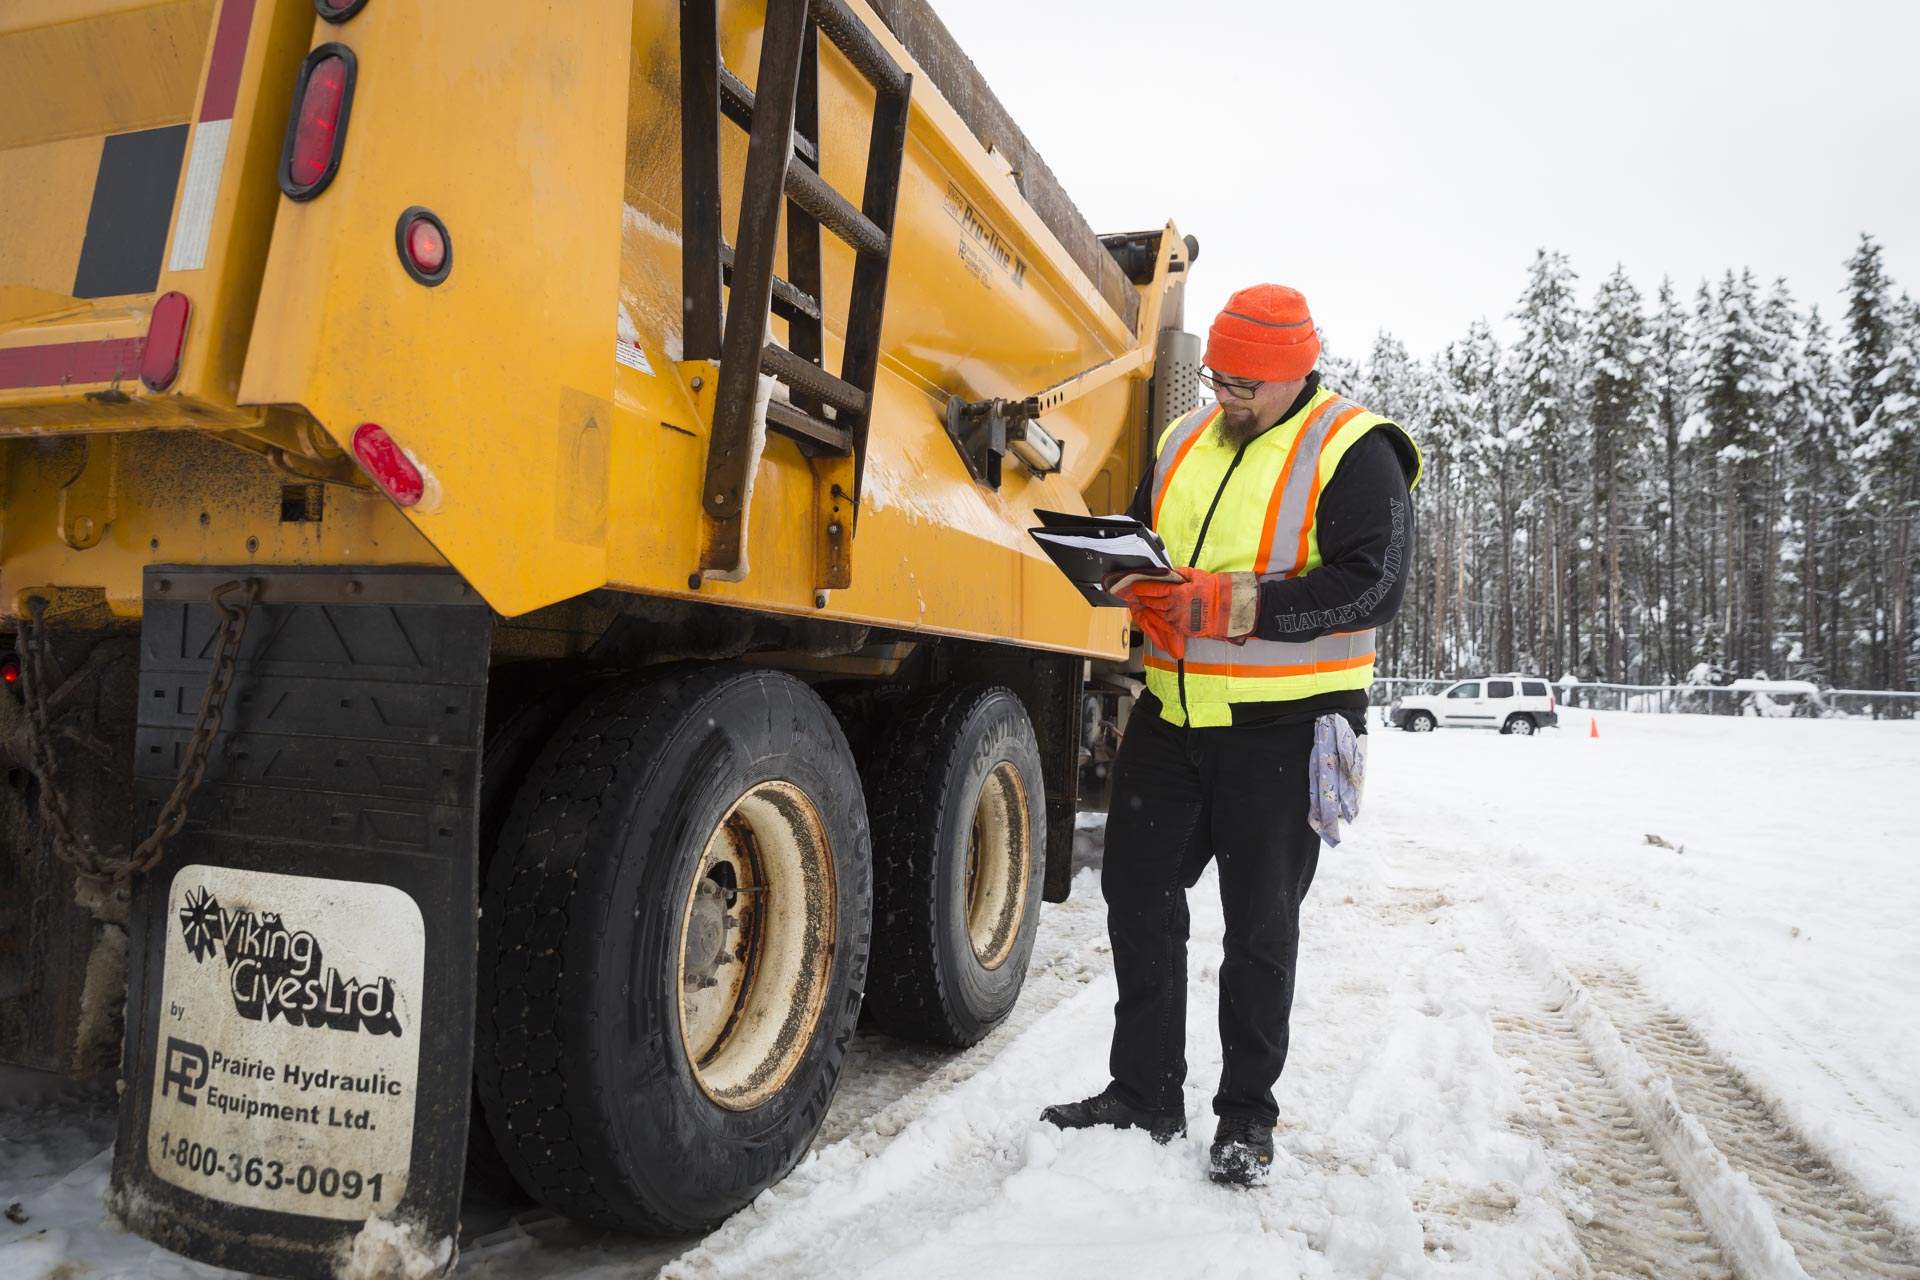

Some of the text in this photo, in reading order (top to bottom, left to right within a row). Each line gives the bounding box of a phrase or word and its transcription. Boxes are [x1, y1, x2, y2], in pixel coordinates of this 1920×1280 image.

[962, 204, 1011, 270] Pro-line
[1275, 497, 1405, 633] HARLEY-DAVIDSON
[219, 908, 320, 976] Viking
[169, 1001, 185, 1021] by
[231, 957, 402, 1036] Cives Ltd.
[211, 1050, 402, 1096] Prairie Hydraulic
[206, 1086, 377, 1131] Equipment Ltd.
[160, 1132, 384, 1203] 1-800-363-0091
